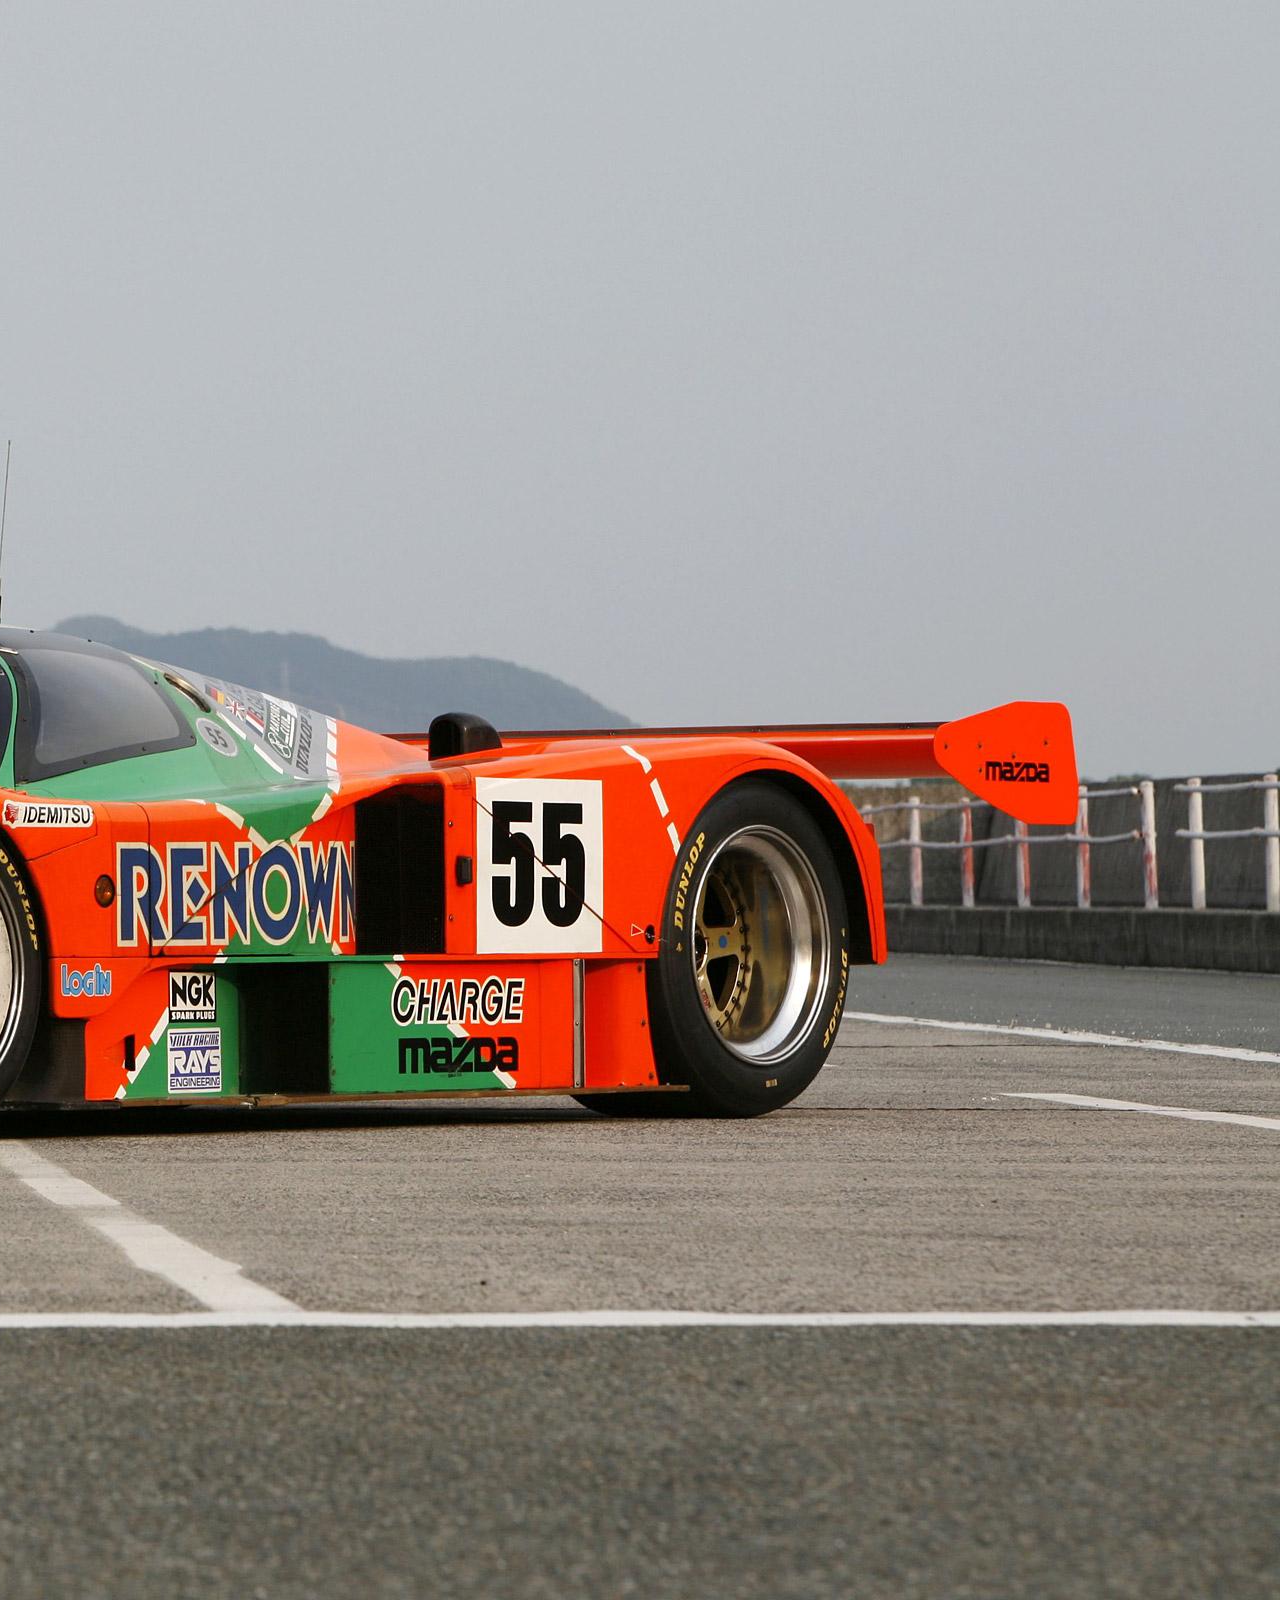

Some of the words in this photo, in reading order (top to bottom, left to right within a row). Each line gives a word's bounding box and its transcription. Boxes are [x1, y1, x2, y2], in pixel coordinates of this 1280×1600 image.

[204, 726, 228, 748] 55
[295, 715, 312, 775] DUNLOP
[985, 761, 1050, 783] mazda
[23, 806, 90, 824] IDEMITSU
[491, 800, 586, 928] 55
[674, 832, 706, 931] DUNLOP
[171, 975, 215, 1007] NGK
[391, 975, 525, 1027] CHARGE
[171, 1011, 194, 1020] SPARK
[196, 1010, 215, 1020] PLUGS
[170, 1049, 220, 1074] RAYS
[398, 1037, 518, 1074] mazda
[170, 1077, 220, 1087] ENGINEERING
